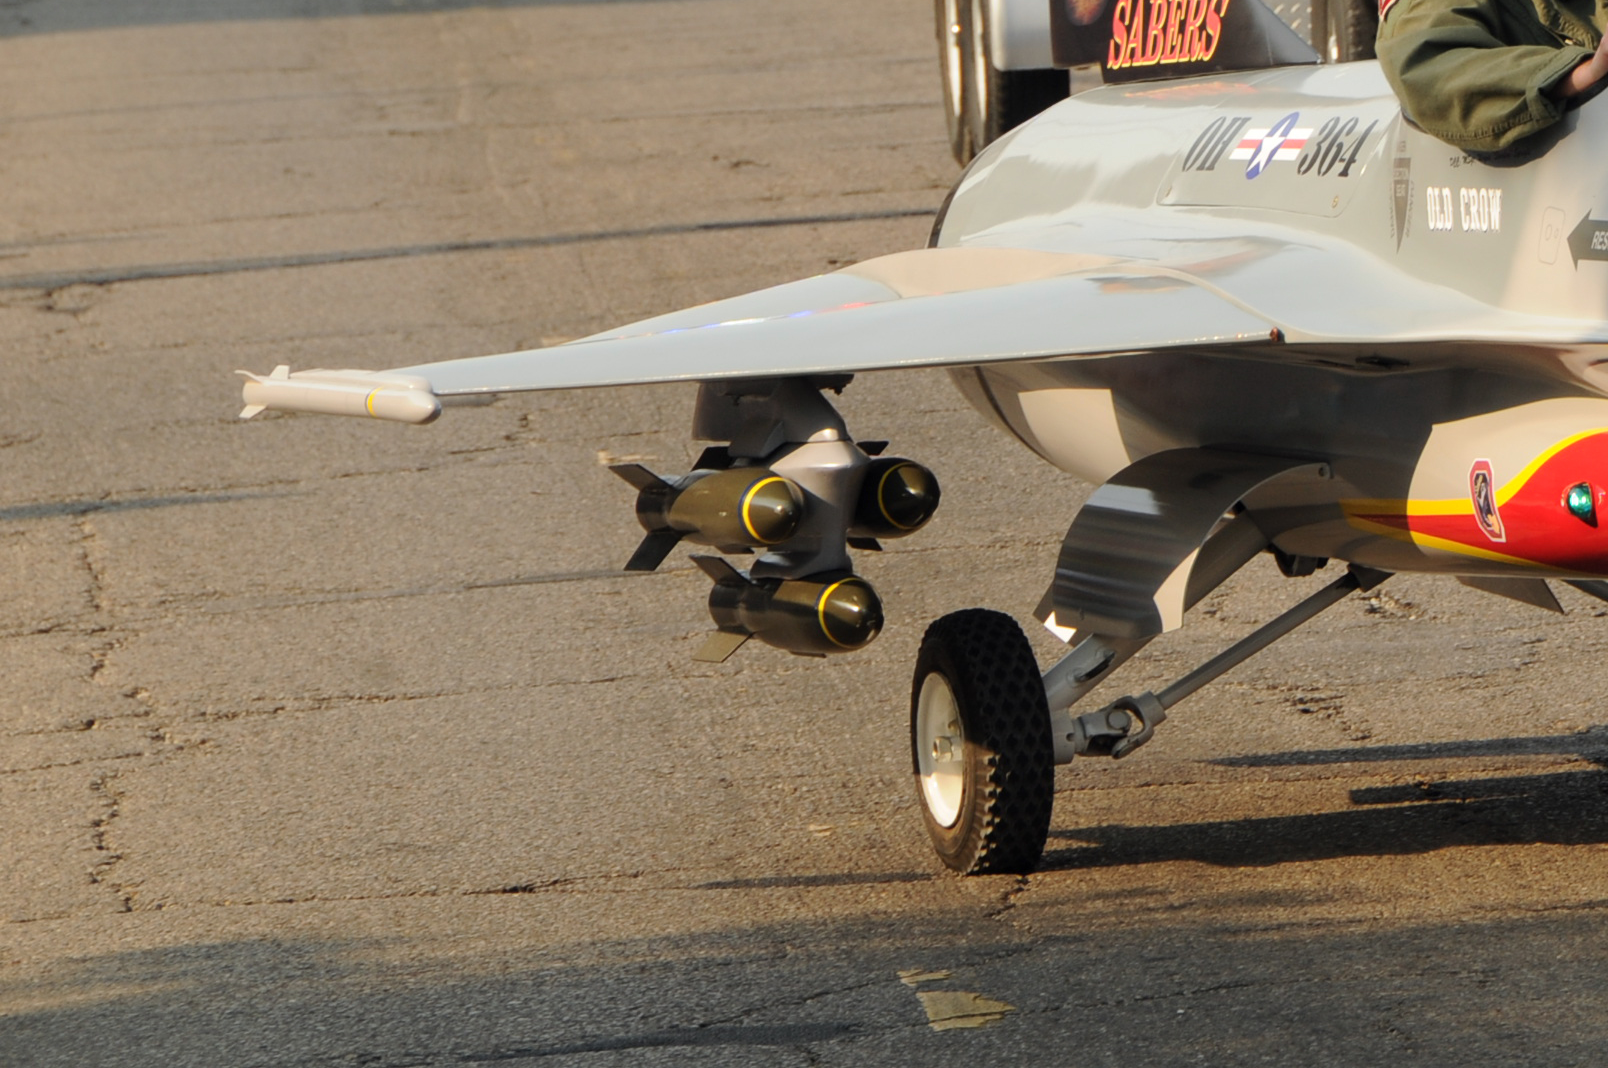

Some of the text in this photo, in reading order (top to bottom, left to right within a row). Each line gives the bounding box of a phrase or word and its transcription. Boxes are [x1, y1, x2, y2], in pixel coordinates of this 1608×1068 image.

[1181, 116, 1380, 178] OH 364
[1426, 186, 1453, 232] OLD
[1459, 186, 1503, 233] CROW
